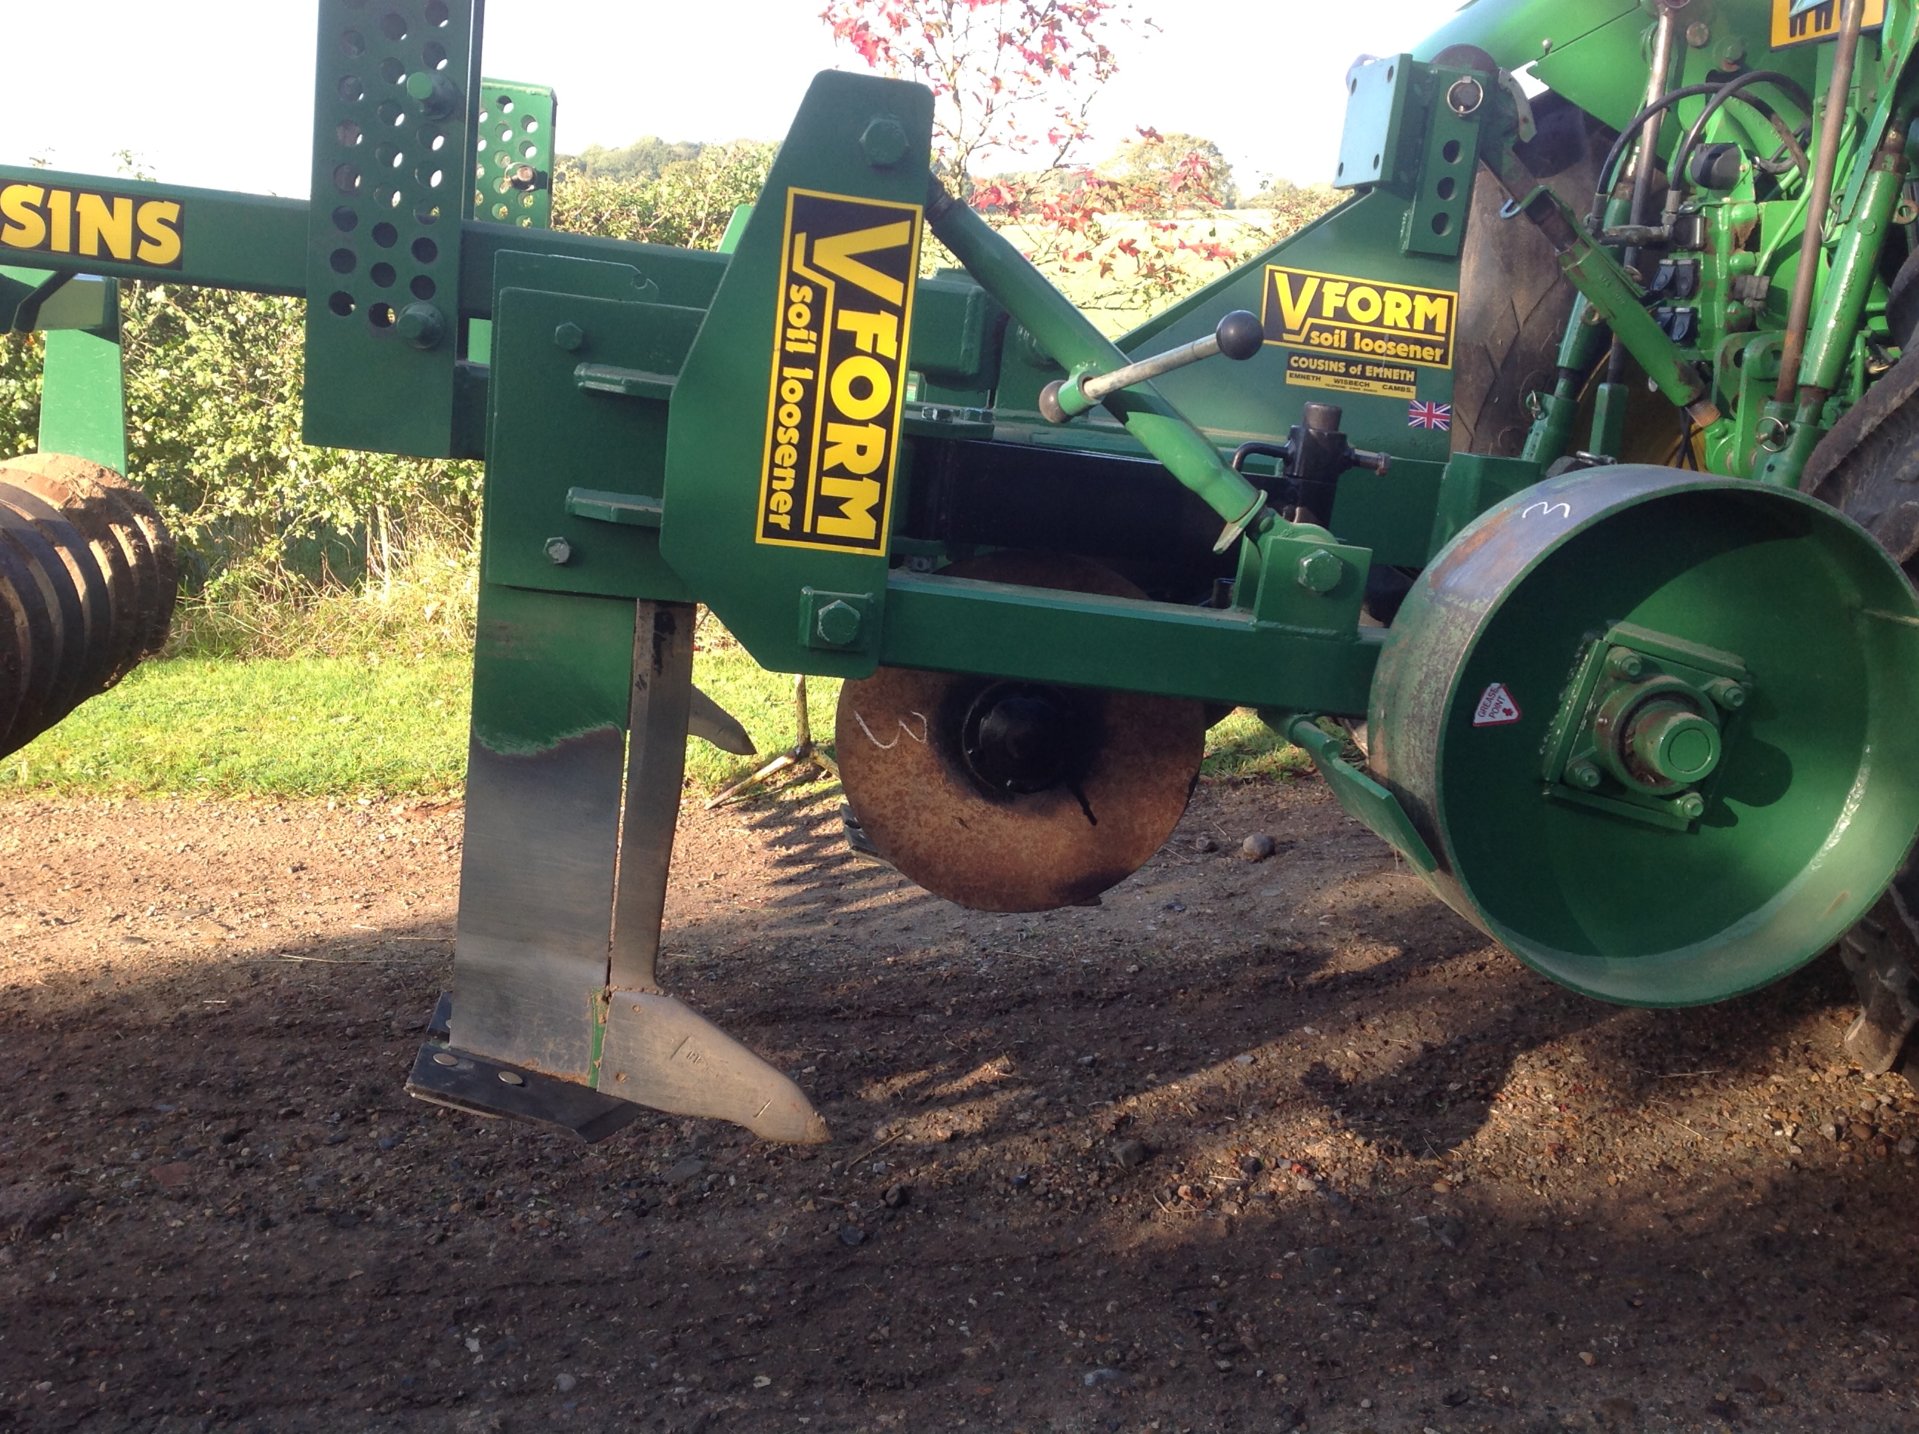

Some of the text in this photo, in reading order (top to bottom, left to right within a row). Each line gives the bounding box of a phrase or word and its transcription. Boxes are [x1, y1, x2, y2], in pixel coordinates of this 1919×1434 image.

[0, 184, 181, 265] SINS
[1310, 329, 1444, 362] soil loosener
[1290, 356, 1415, 382] COUSINS of EMNETH
[1333, 378, 1370, 388] WISBECH
[768, 283, 816, 532] soil loosener
[1477, 687, 1500, 718] GREASE
[1488, 695, 1506, 719] POINT
